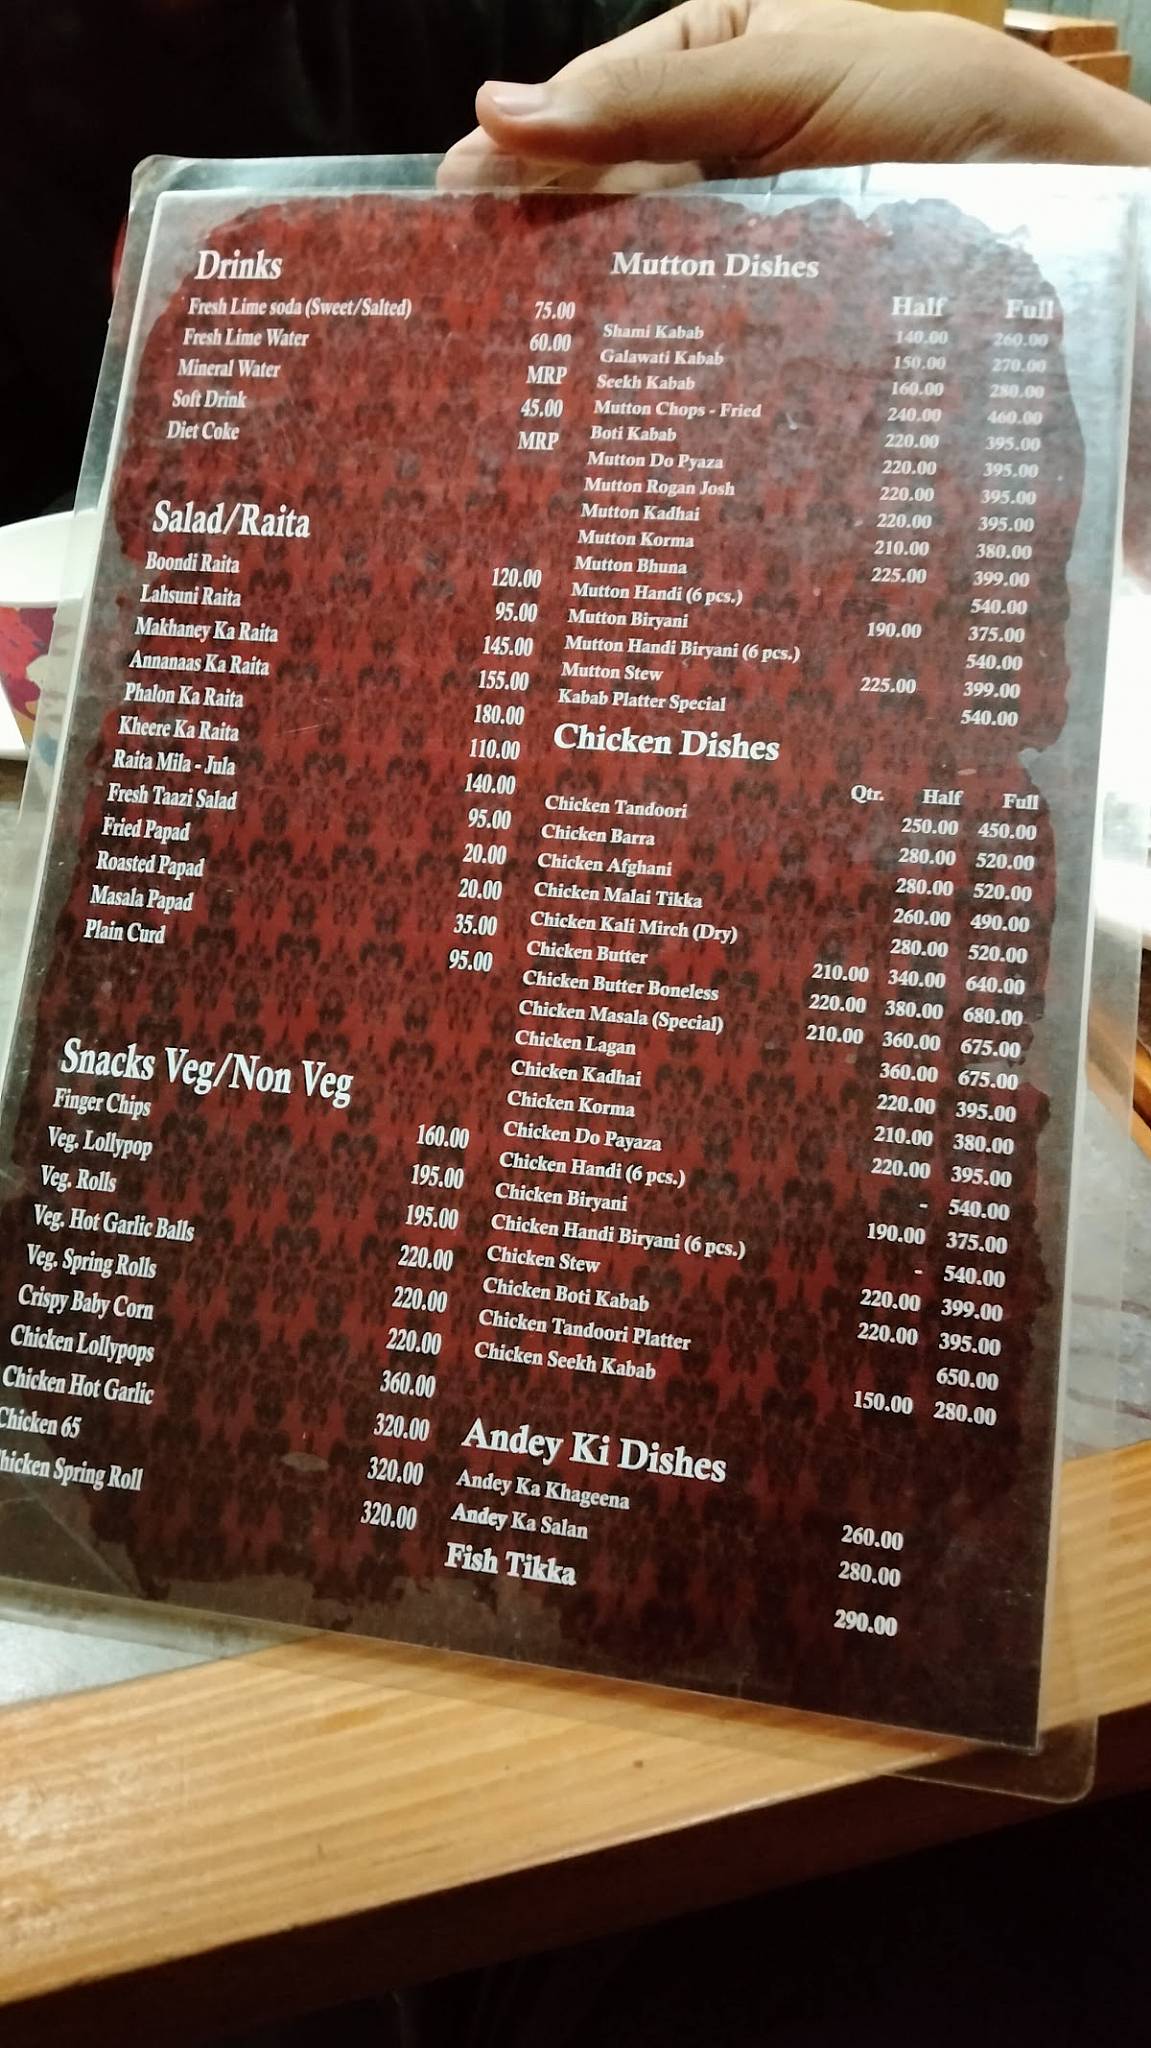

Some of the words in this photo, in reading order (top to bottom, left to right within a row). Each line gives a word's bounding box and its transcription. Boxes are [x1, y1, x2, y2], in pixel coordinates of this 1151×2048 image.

[194, 249, 283, 281] Drinks
[611, 252, 715, 276] Mutton
[723, 253, 820, 279] Dishes
[188, 297, 227, 315] Fresh
[229, 297, 268, 315] Lime
[269, 297, 302, 316] soda
[305, 297, 412, 320] (Sweet/Salted)
[535, 300, 576, 320] 75.00
[891, 296, 948, 317] Half
[1005, 297, 1055, 320] Full
[603, 323, 651, 339] Shami
[654, 324, 704, 340] Kabab
[896, 330, 949, 345] 140.00
[993, 332, 1049, 349] 260.00
[177, 358, 234, 377] Mineral
[238, 359, 281, 378] Water
[525, 365, 568, 385] MRP
[596, 374, 642, 389] Seekh
[645, 375, 696, 391] Kabab
[892, 381, 945, 397] 160.00
[989, 383, 1045, 399] 280.00
[172, 389, 202, 408] Soft
[203, 389, 247, 409] Drink
[520, 398, 564, 418] 45.00
[166, 420, 200, 439] Diet
[201, 421, 240, 440] Coke
[517, 431, 560, 451] MRP
[587, 451, 646, 467] Mutton
[649, 452, 674, 468] Do
[677, 453, 724, 472] Pyaza
[881, 459, 937, 475] 220.00
[983, 462, 1039, 479] 395.00
[152, 500, 311, 538] Salad/Raita
[580, 503, 639, 520] Mutton
[643, 505, 700, 522] Kadhai
[876, 512, 933, 529] 220.00
[978, 515, 1035, 533] 395.00
[144, 551, 198, 572] Boondi
[199, 553, 240, 574] Raita
[574, 555, 633, 573] Mutton
[636, 558, 688, 575] Bhuna
[491, 567, 543, 588] 120.00
[871, 566, 927, 584] 225.00
[973, 570, 1031, 588] 399.00
[134, 616, 212, 643] Makhaney
[212, 620, 236, 640] Ka
[237, 622, 279, 643] Raita
[567, 608, 627, 626] Mutton
[629, 611, 689, 631] Biryani
[867, 622, 922, 639] 190.00
[968, 625, 1026, 643] 375.00
[482, 635, 534, 657] 145.00
[560, 661, 621, 679] Mutton
[624, 664, 664, 681] Stew
[123, 681, 176, 704] Phalon
[177, 685, 200, 705] Ka
[202, 687, 244, 708] Raita
[859, 676, 917, 694] 225.00
[963, 681, 1021, 699] 399.00
[474, 704, 525, 726] 180.00
[554, 723, 672, 755] Chicken
[678, 730, 780, 761] Dishes
[106, 782, 149, 804] Fresh
[152, 785, 193, 807] Taazi
[195, 788, 238, 810] Salad
[545, 795, 610, 814] Chicken
[614, 799, 688, 819] Tandoori
[850, 784, 884, 804] Qtr.
[922, 788, 964, 806] Half
[1002, 793, 1040, 810] Full
[468, 807, 512, 830] 95.00
[901, 817, 959, 836] 250.00
[977, 822, 1037, 841] 450.00
[95, 850, 157, 873] Roasted
[157, 854, 205, 881] Papad
[537, 852, 604, 872] Chicken
[606, 857, 673, 878] Afghani
[457, 878, 503, 901] 20.00
[895, 877, 954, 897] 280.00
[973, 883, 1033, 902] 520.00
[83, 918, 124, 941] Plain
[126, 922, 166, 944] Curd
[530, 911, 597, 931] Chicken
[599, 916, 636, 934] Kali
[638, 919, 689, 938] Mirch
[692, 923, 738, 945] (Dry)
[449, 949, 493, 972] 95.00
[889, 938, 949, 958] 280.00
[968, 944, 1028, 964] 520.00
[522, 969, 589, 990] Chicken
[591, 975, 645, 995] Butter
[646, 980, 719, 1001] Boneless
[808, 993, 867, 1014] 220.00
[885, 999, 944, 1020] 380.00
[963, 1006, 1024, 1027] 680.00
[515, 1029, 582, 1051] Chicken
[584, 1035, 636, 1057] Lagan
[60, 1037, 156, 1081] Snacks
[164, 1046, 292, 1095] Veg/Non
[301, 1060, 354, 1109] Veg
[879, 1062, 939, 1083] 360.00
[958, 1070, 1020, 1091] 675.00
[52, 1087, 105, 1115] Finger
[106, 1092, 152, 1121] Chips
[507, 1090, 575, 1112] Chicken
[577, 1096, 636, 1118] Korma
[416, 1124, 470, 1149] 160.00
[873, 1125, 934, 1147] 210.00
[953, 1133, 1015, 1155] 380.00
[41, 1164, 72, 1193] Veg.
[75, 1168, 117, 1193] Rolls
[495, 1182, 563, 1205] Chicken
[565, 1189, 628, 1213] Biryani
[405, 1204, 459, 1230] 195.00
[867, 1222, 926, 1245] 190.00
[945, 1231, 1008, 1255] 375.00
[27, 1243, 58, 1272] Veg.
[62, 1247, 115, 1279] Spring
[114, 1253, 157, 1279] Rolls
[391, 1285, 448, 1313] 220.00
[482, 1276, 551, 1301] Chicken
[554, 1284, 591, 1305] Boti
[594, 1289, 650, 1312] Kabab
[10, 1324, 74, 1353] Chicken
[75, 1331, 155, 1367] Lollypops
[857, 1322, 919, 1346] 220.00
[938, 1332, 1002, 1357] 395.00
[474, 1341, 543, 1366] Chicken
[547, 1350, 597, 1373] Seekh
[600, 1356, 656, 1380] Kabab
[379, 1369, 436, 1398] 360.00
[853, 1390, 914, 1415] 150.00
[933, 1400, 997, 1426] 280.00
[0, 1406, 58, 1436] Chicken
[60, 1415, 82, 1439] 65
[461, 1417, 565, 1466] Andey
[569, 1431, 610, 1466] Ki
[617, 1438, 727, 1483] Dishes
[0, 1448, 51, 1478] hicken
[52, 1456, 106, 1491] Spring
[107, 1464, 144, 1491] Roll
[367, 1456, 424, 1486] 320.00
[455, 1469, 513, 1497] Andey
[514, 1476, 541, 1497] Ka
[544, 1480, 630, 1510] Khageena
[360, 1500, 418, 1531] 320.00
[841, 1524, 904, 1551] 260.00
[444, 1541, 499, 1574] Fish
[505, 1550, 577, 1586] Tikka
[833, 1609, 898, 1637] 290.00
